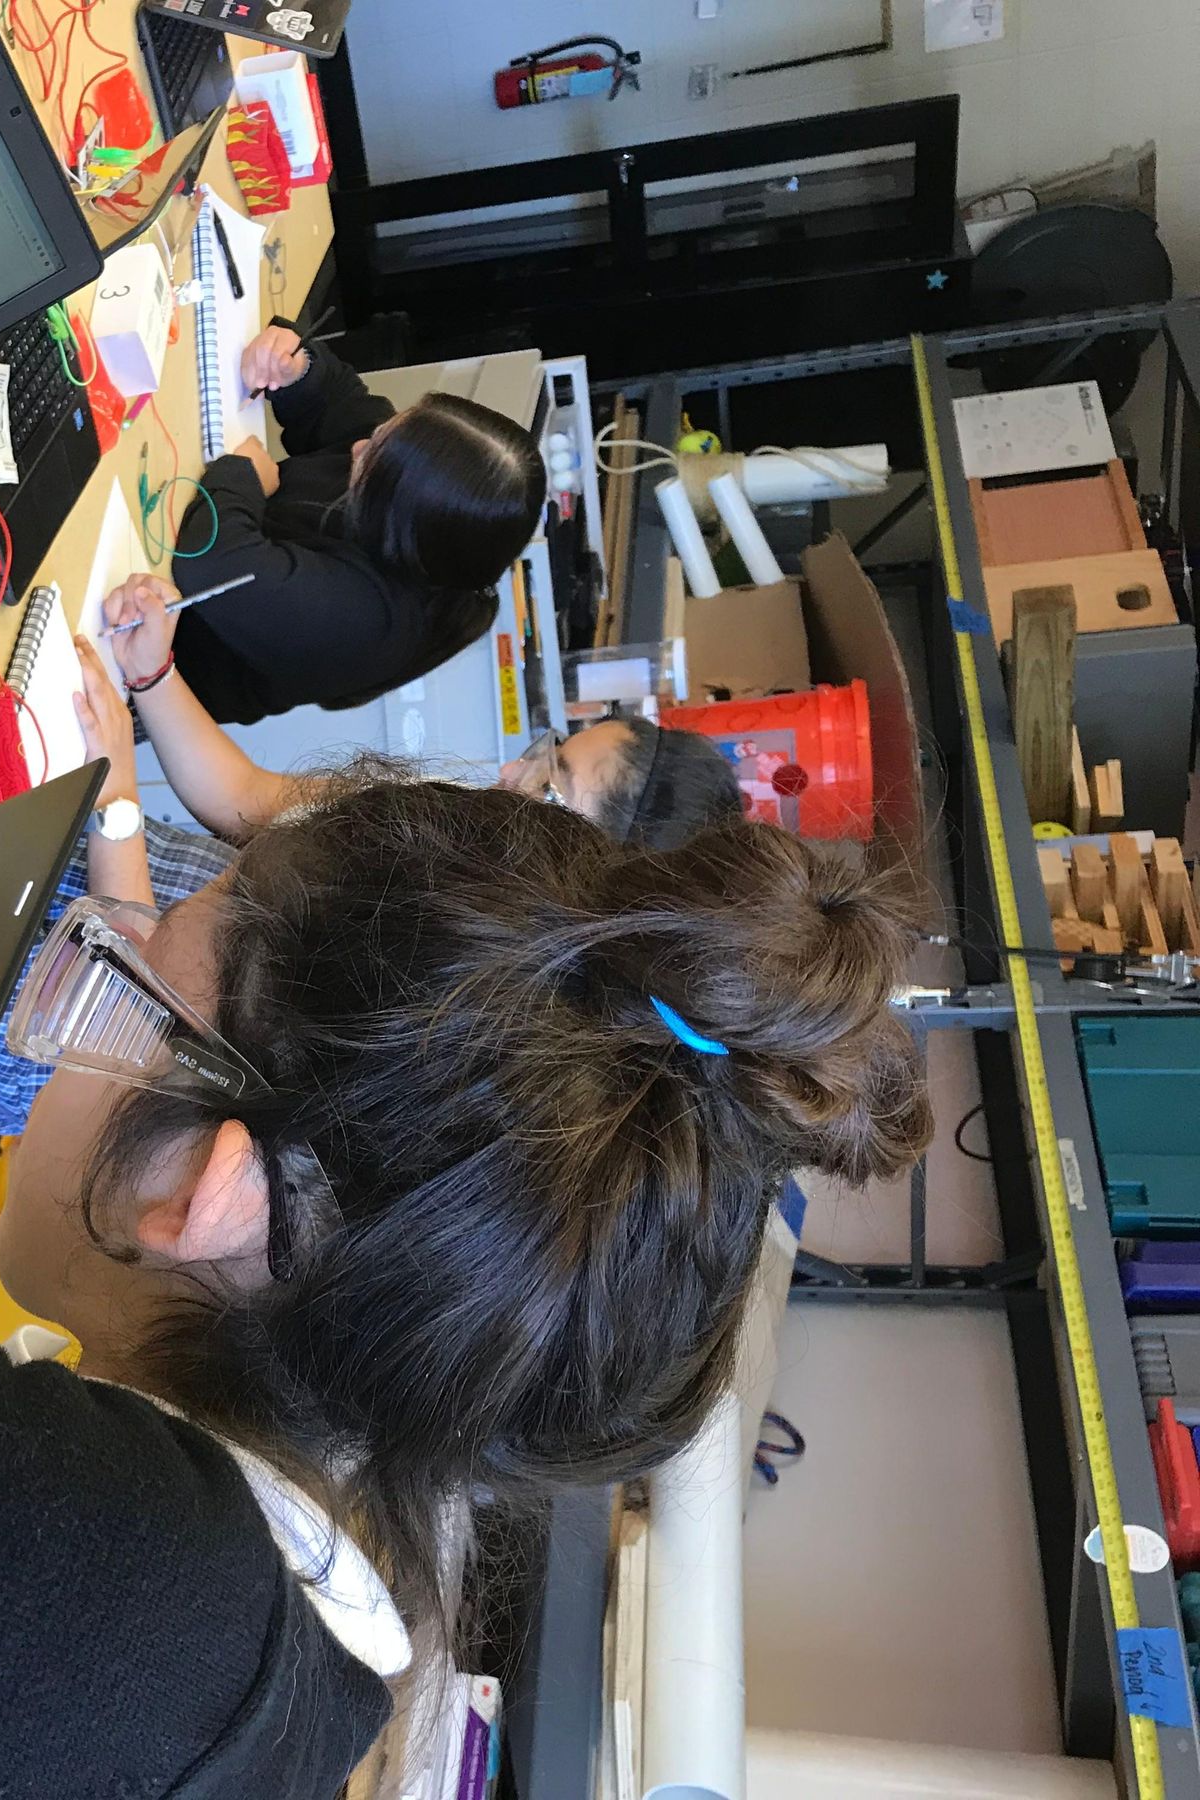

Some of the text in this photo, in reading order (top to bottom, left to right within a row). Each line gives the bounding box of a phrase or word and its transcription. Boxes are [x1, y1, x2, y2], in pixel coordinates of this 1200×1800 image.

[100, 286, 130, 300] 3
[1120, 1650, 1160, 1696] Period
[1142, 1640, 1178, 1680] 2nd
